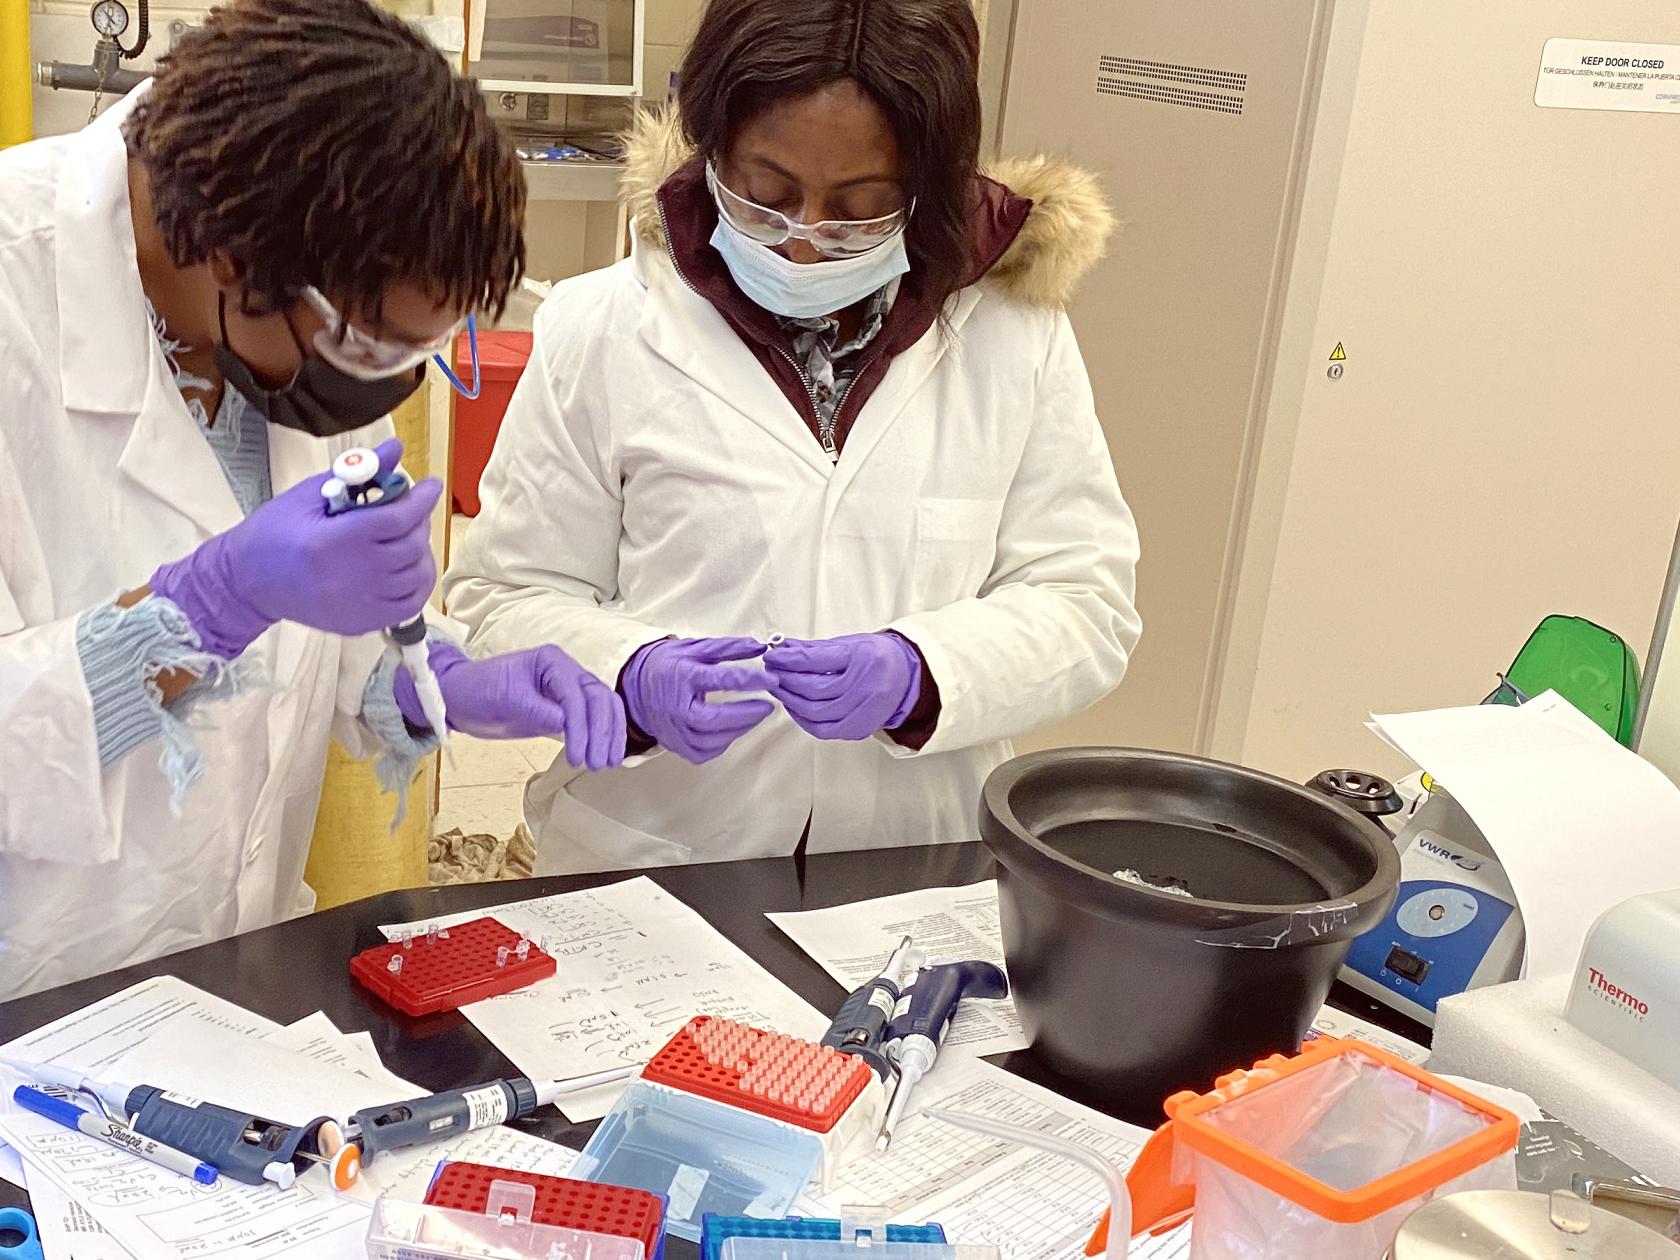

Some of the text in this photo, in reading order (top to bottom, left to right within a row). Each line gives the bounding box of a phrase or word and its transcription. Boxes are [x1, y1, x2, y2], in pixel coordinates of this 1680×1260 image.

[1581, 56, 1665, 69] KEEP DOOR CLOSED
[1419, 838, 1451, 860] VWR
[1587, 984, 1646, 1024] SCIENTIFIC
[1588, 966, 1649, 1015] Thermo
[100, 1122, 142, 1151] Sharpie
